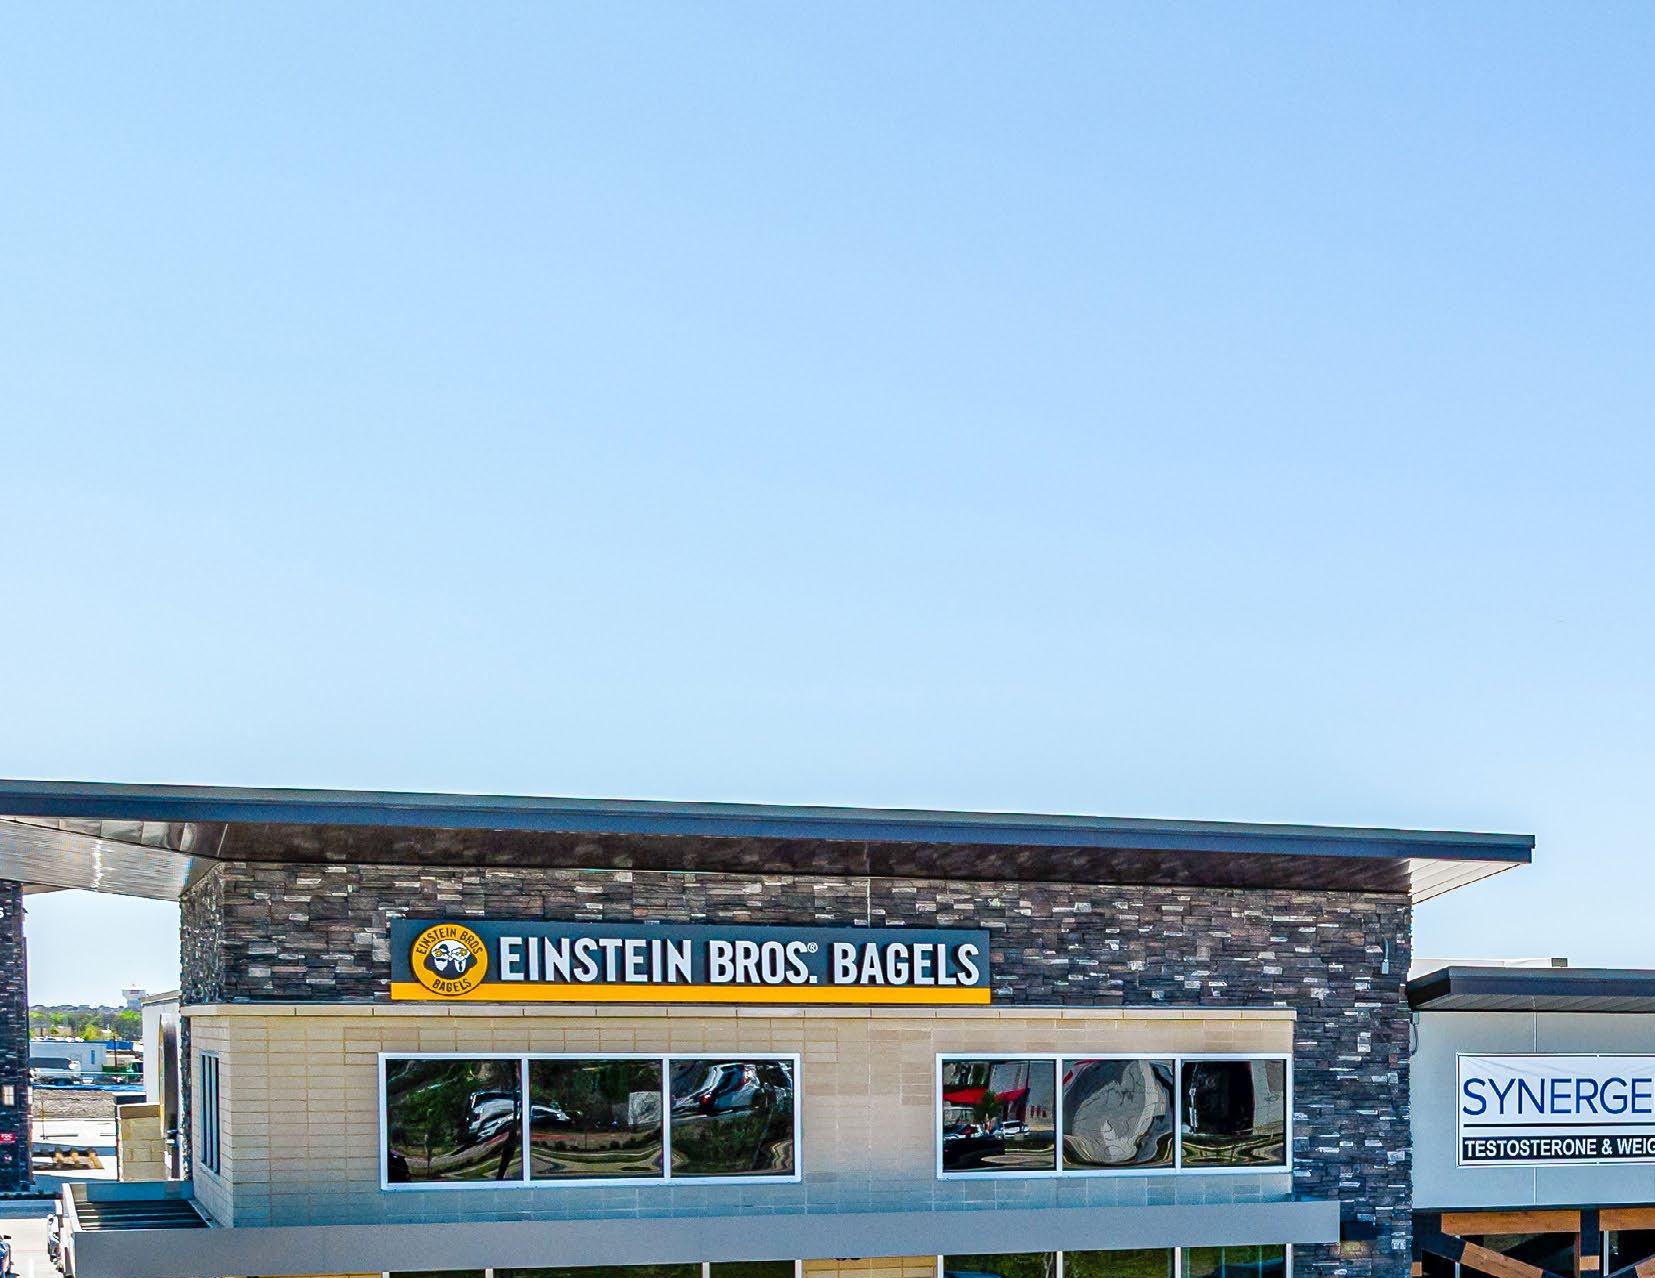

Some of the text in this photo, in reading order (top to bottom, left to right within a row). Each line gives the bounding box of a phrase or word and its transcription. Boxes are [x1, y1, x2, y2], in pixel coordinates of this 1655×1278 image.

[416, 928, 483, 955] EINSTEIN BROS
[500, 937, 692, 983] EINSTEIN
[833, 943, 980, 986] BAGELS
[432, 979, 472, 992] BAGELS
[1464, 1138, 1597, 1157] TESTOSTERONE
[1602, 1139, 1613, 1155] &
